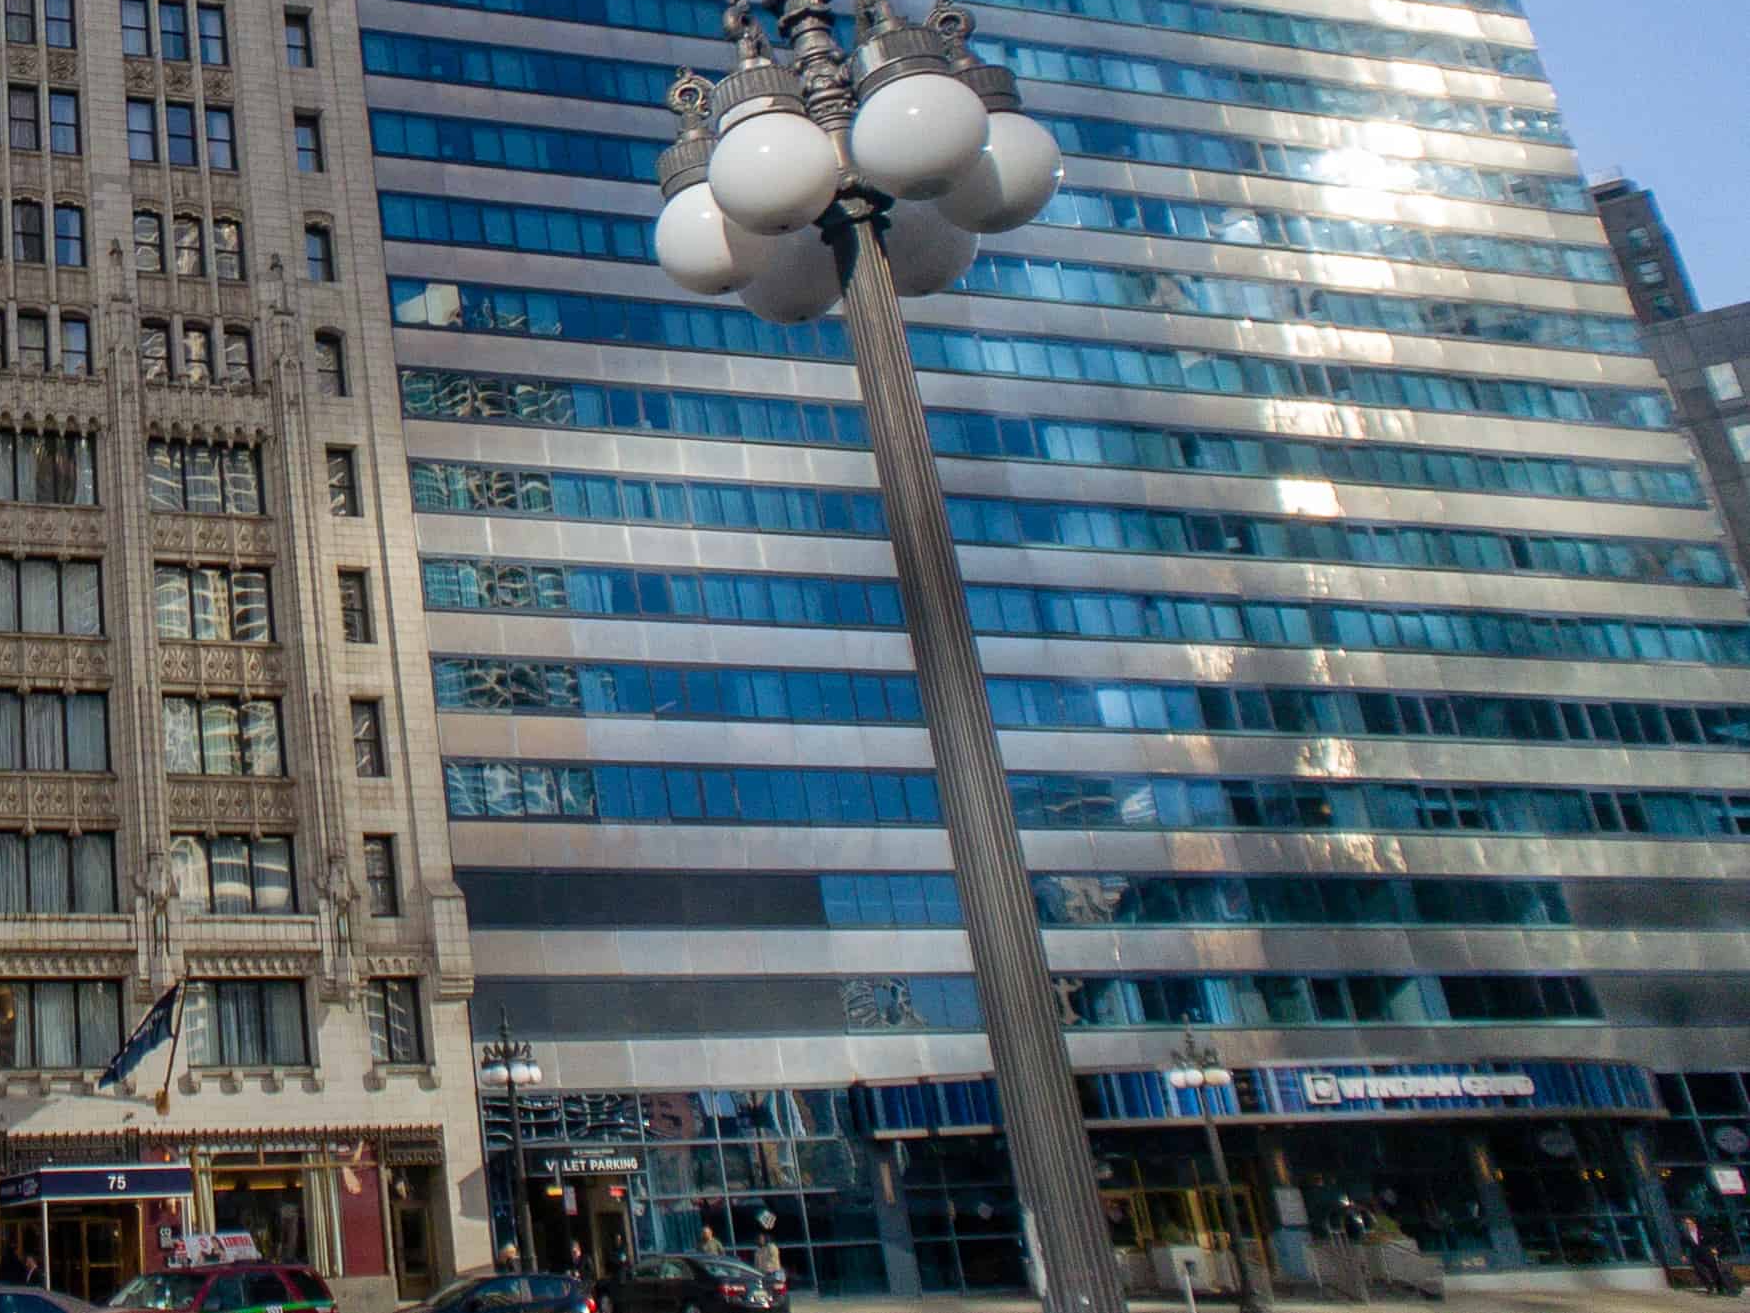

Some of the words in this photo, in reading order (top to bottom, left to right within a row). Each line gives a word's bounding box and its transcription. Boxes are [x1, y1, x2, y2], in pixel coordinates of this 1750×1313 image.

[545, 1159, 587, 1172] VLET
[589, 1158, 638, 1171] PARKING
[107, 1175, 127, 1191] 75
